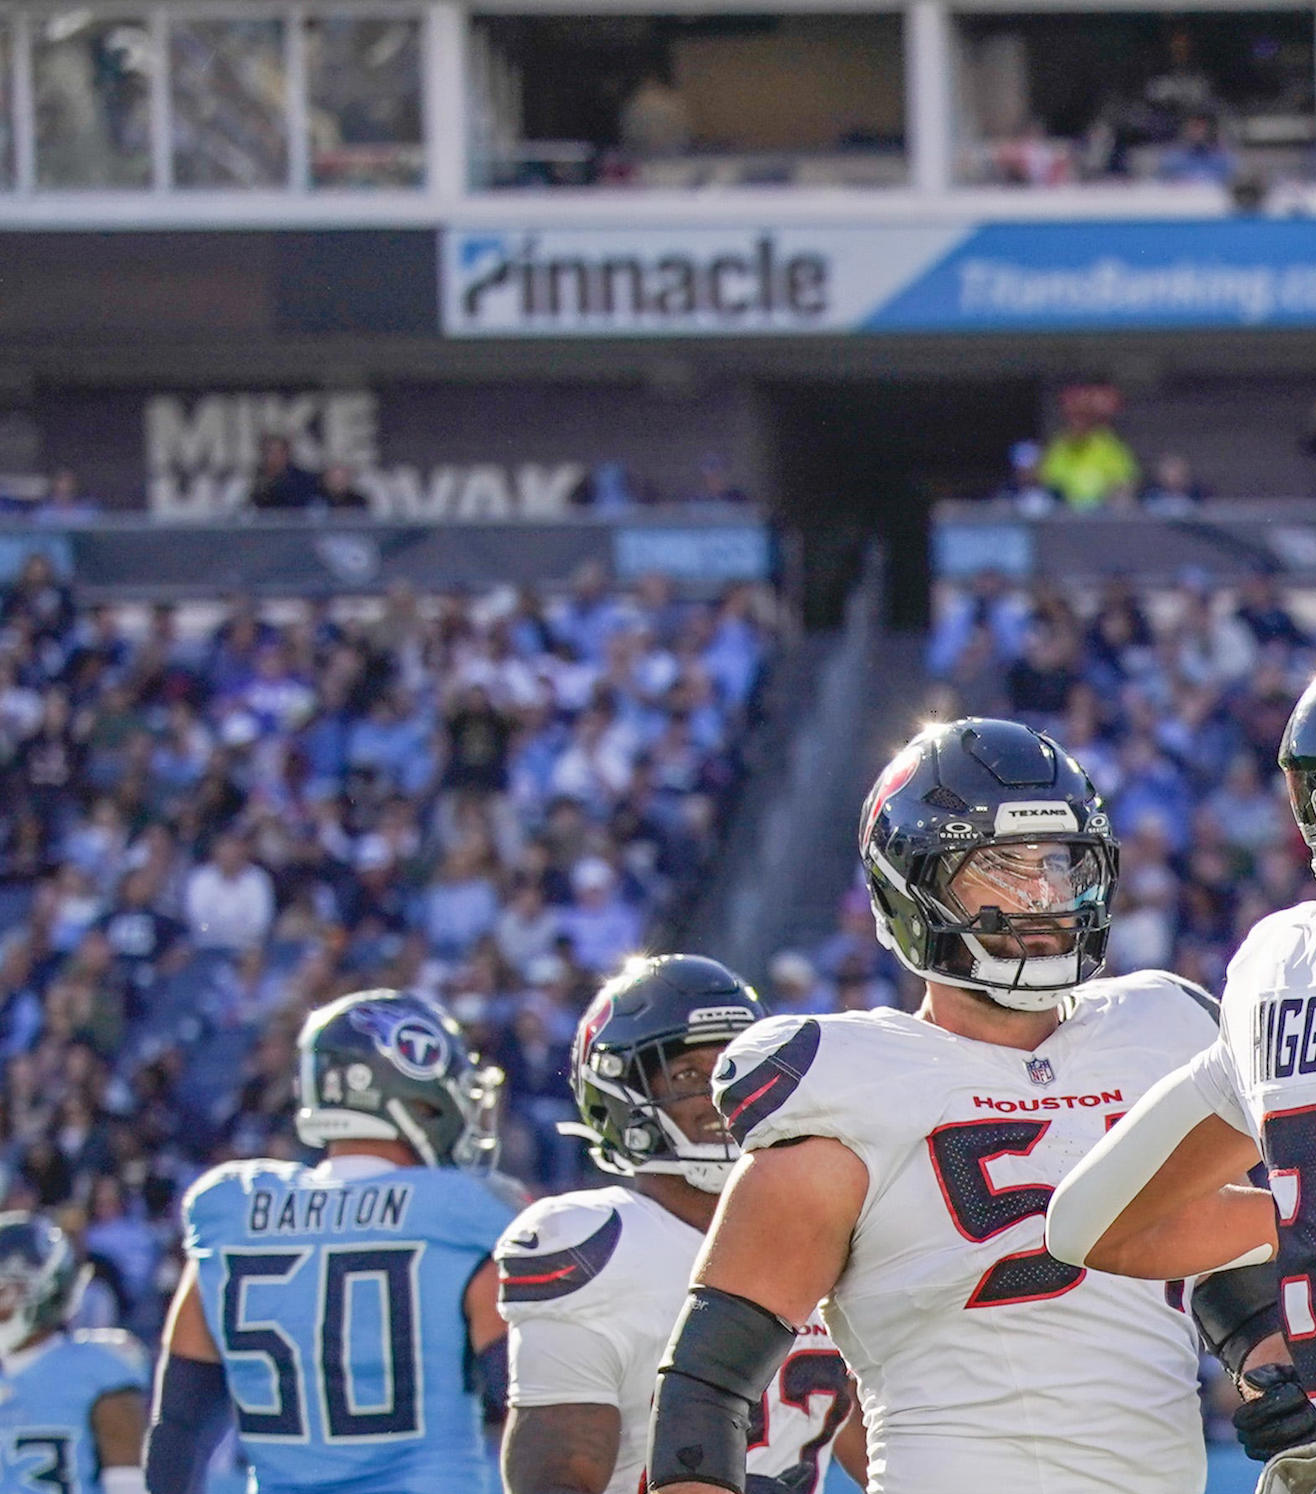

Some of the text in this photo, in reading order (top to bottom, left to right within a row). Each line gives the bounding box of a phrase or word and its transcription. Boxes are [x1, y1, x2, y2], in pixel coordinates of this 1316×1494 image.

[462, 226, 828, 318] Pinnacle
[146, 394, 379, 468] MIKE
[1008, 808, 1068, 817] TEXANS
[973, 1089, 1123, 1113] HOUSTON
[249, 1185, 412, 1237] BARTON
[220, 1240, 425, 1445] 50
